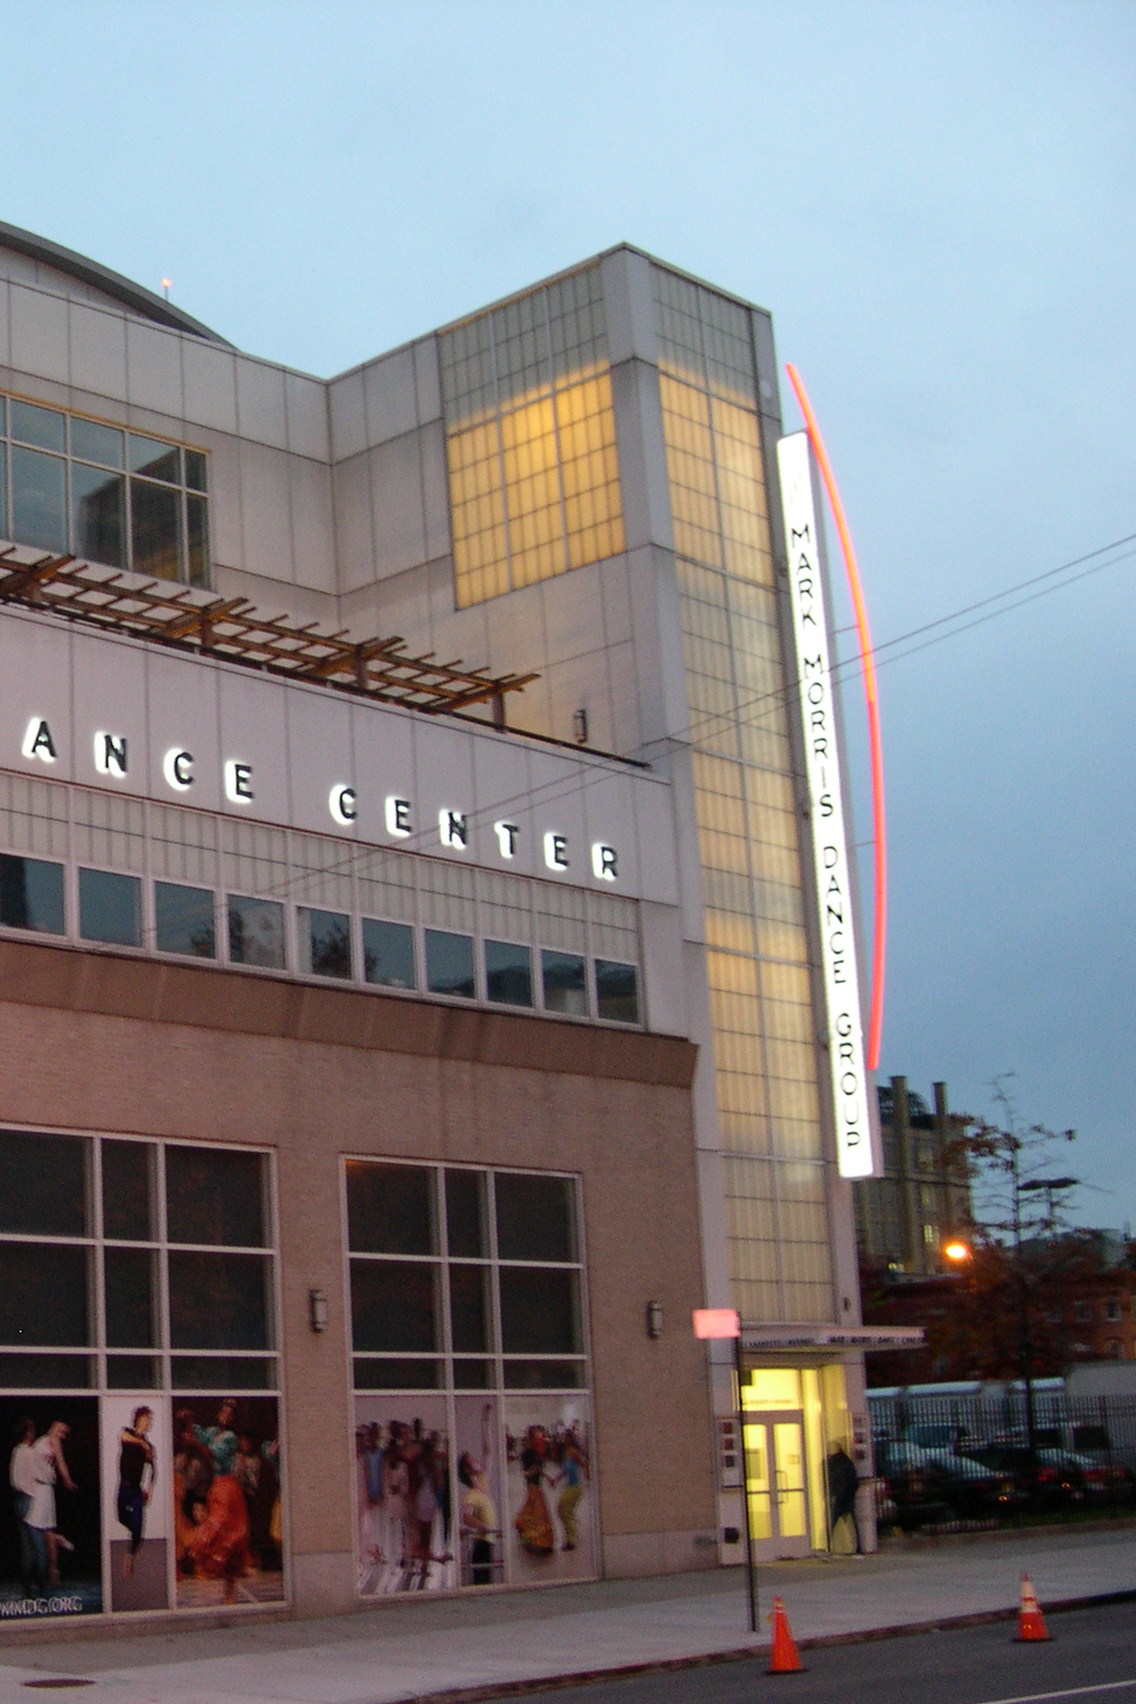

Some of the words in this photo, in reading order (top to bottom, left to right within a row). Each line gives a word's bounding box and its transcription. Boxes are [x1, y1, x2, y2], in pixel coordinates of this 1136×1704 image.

[790, 523, 816, 627] MARK
[802, 654, 835, 818] MORRIS
[330, 784, 619, 881] CENTER
[822, 845, 848, 985] DANCE
[835, 1012, 862, 1148] GROUP
